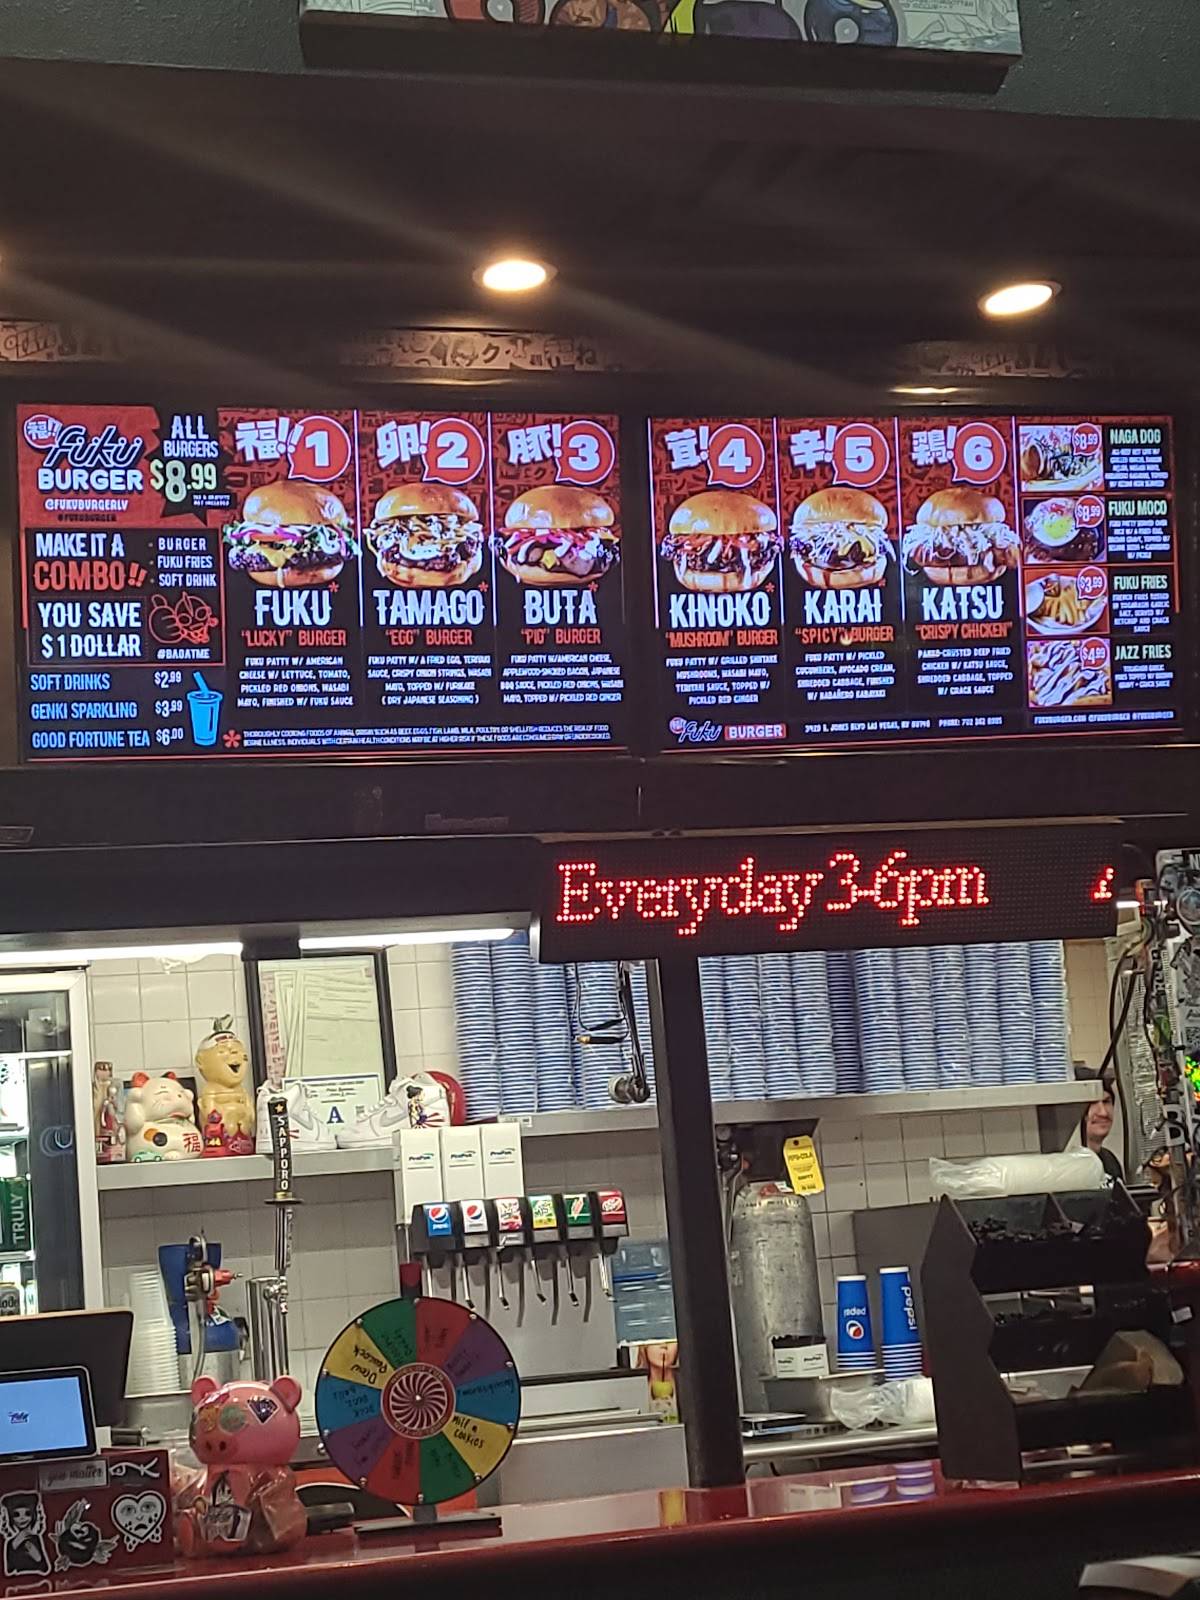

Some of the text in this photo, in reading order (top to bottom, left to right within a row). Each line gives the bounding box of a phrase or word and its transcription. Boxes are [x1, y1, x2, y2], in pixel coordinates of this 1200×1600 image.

[171, 416, 209, 439] ALL
[1110, 429, 1161, 444] NAGA DOG
[163, 441, 218, 457] BURGERS
[305, 431, 329, 466] 1
[437, 432, 469, 469] 2
[568, 435, 600, 471] 3
[718, 438, 752, 472] 4
[845, 436, 874, 472] 5
[963, 436, 993, 471] 6
[38, 469, 143, 491] BURGER
[150, 459, 217, 502] $8.99
[45, 499, 128, 510] @FUKUBURGERLV
[1109, 500, 1167, 516] FUKU MOCO
[36, 534, 124, 557] MAKE IT A
[158, 538, 206, 550] BURGER
[158, 556, 212, 568] FUKU FRIES
[33, 561, 148, 591] COMBO!!
[159, 574, 216, 586] SOFT DRINK
[1114, 575, 1167, 590] FUKU FRIES
[255, 590, 332, 626] FUKU
[373, 590, 485, 625] TAMAGO
[524, 589, 597, 625] BUTA
[669, 591, 771, 628] KINOKO
[804, 588, 882, 624] KARAI
[922, 586, 1004, 621] KATSU
[38, 602, 141, 627] YOU SAVE
[299, 630, 346, 646] BURGER
[426, 629, 472, 645] BURGER
[556, 629, 601, 644] BURGER
[737, 629, 777, 645] BURGER
[851, 626, 895, 642] BURGER
[70, 634, 141, 657] DOLLAR
[974, 648, 990, 656] DEEP
[1115, 644, 1172, 660] JAZZ FRIES
[245, 657, 343, 666] FUKU PATTY W/ AMERICAN
[386, 655, 406, 665] PATTY
[685, 657, 706, 666] PATTY
[824, 653, 844, 661] PATTY
[858, 651, 885, 660] PICKLED
[31, 671, 182, 690] SOFT DRINKS $2.99
[268, 670, 279, 680] W/
[319, 670, 350, 680] TOMATO,
[987, 672, 1013, 681] TOPPED
[241, 683, 271, 693] PICKLED
[274, 683, 288, 693] RED
[407, 681, 432, 692] TOPPED
[732, 682, 758, 690] TOPPED
[974, 685, 994, 694] SAUCE
[297, 696, 307, 707] W/
[310, 696, 328, 707] FUKU
[331, 696, 353, 707] SAUCE
[689, 696, 732, 705] PICKLED RED
[31, 700, 182, 719] GENKI SPARKLING $3.99
[32, 728, 183, 748] GOOD FORTUNE TEA $6.00
[729, 725, 782, 738] BURGER
[556, 850, 990, 937] Everyday 3-6pm
[327, 1106, 344, 1125] A
[278, 1115, 289, 1190] SAPPORO
[12, 1193, 25, 1243] TRULY
[901, 1285, 918, 1331] pepsi
